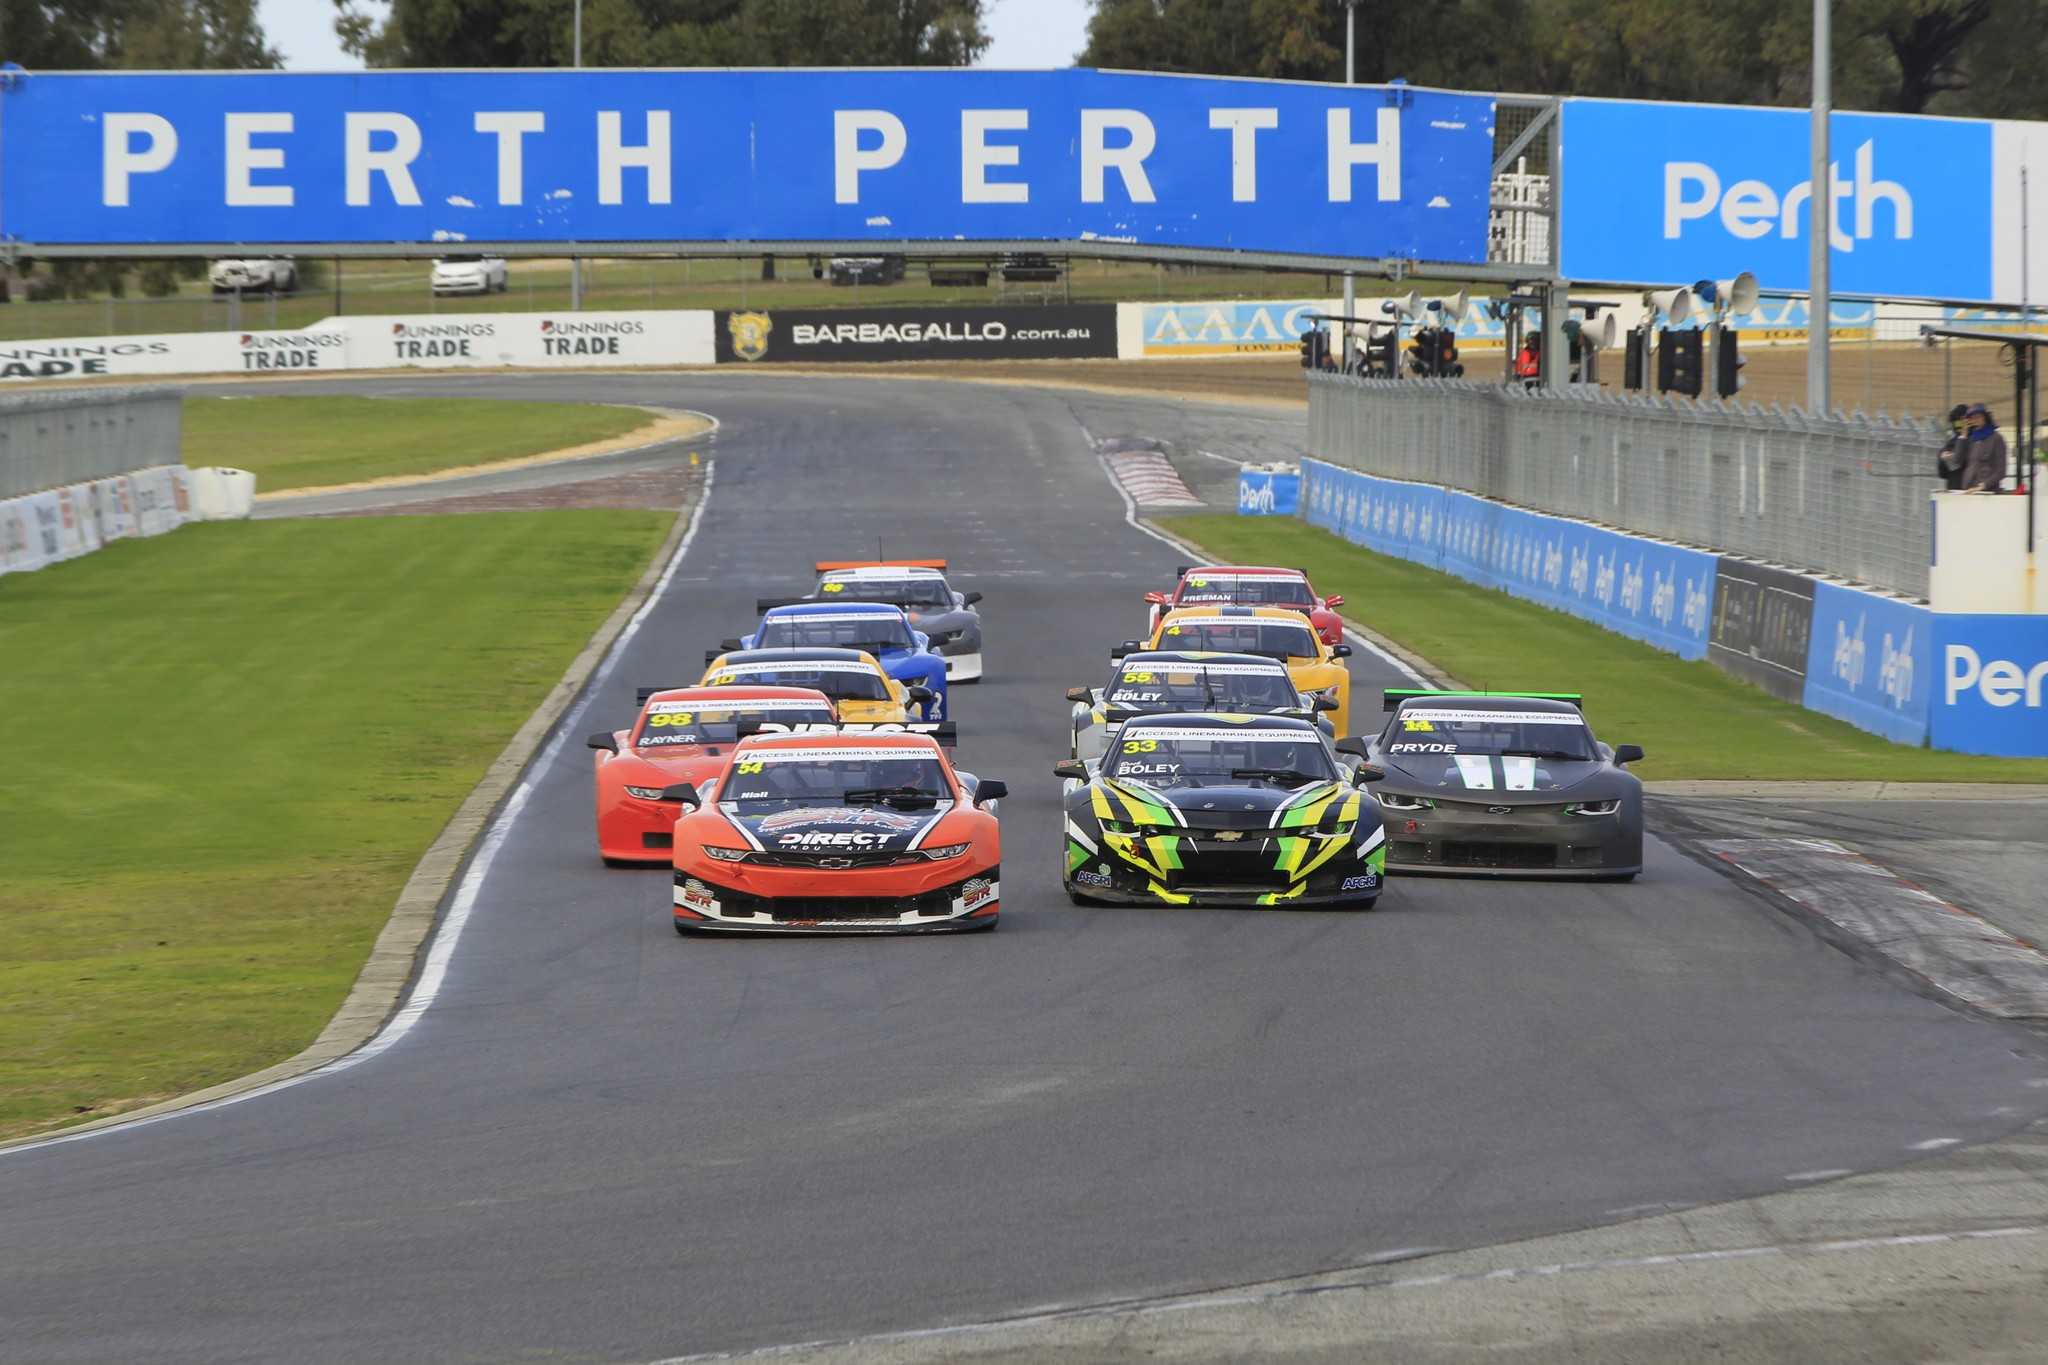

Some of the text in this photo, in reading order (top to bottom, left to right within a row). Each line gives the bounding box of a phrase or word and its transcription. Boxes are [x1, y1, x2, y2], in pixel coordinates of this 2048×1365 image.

[103, 107, 1402, 207] PERTH PERTH
[1664, 138, 1914, 253] Perth
[395, 339, 471, 358] TRADE
[543, 336, 620, 355] TRADE
[242, 350, 319, 369] TRADE
[1240, 475, 1275, 515] Perth
[1182, 594, 1231, 602] FREEMAN
[1166, 625, 1181, 636] 4
[1122, 672, 1152, 683] 55
[1110, 692, 1162, 701] BOLEY
[649, 712, 693, 727] 98
[1403, 720, 1434, 731] 14
[638, 734, 696, 746] RAYNER
[1258, 732, 1316, 740] EQUIPMENT
[1123, 740, 1157, 754] 33
[1389, 743, 1457, 753] PRYDE
[737, 761, 764, 775] 54
[1118, 764, 1180, 775] BOLEY
[778, 833, 898, 845] DIRECT
[1077, 870, 1112, 887] AFGRI
[1341, 875, 1377, 890] AFGRI
[684, 887, 713, 908] STR
[963, 886, 991, 908] STR
